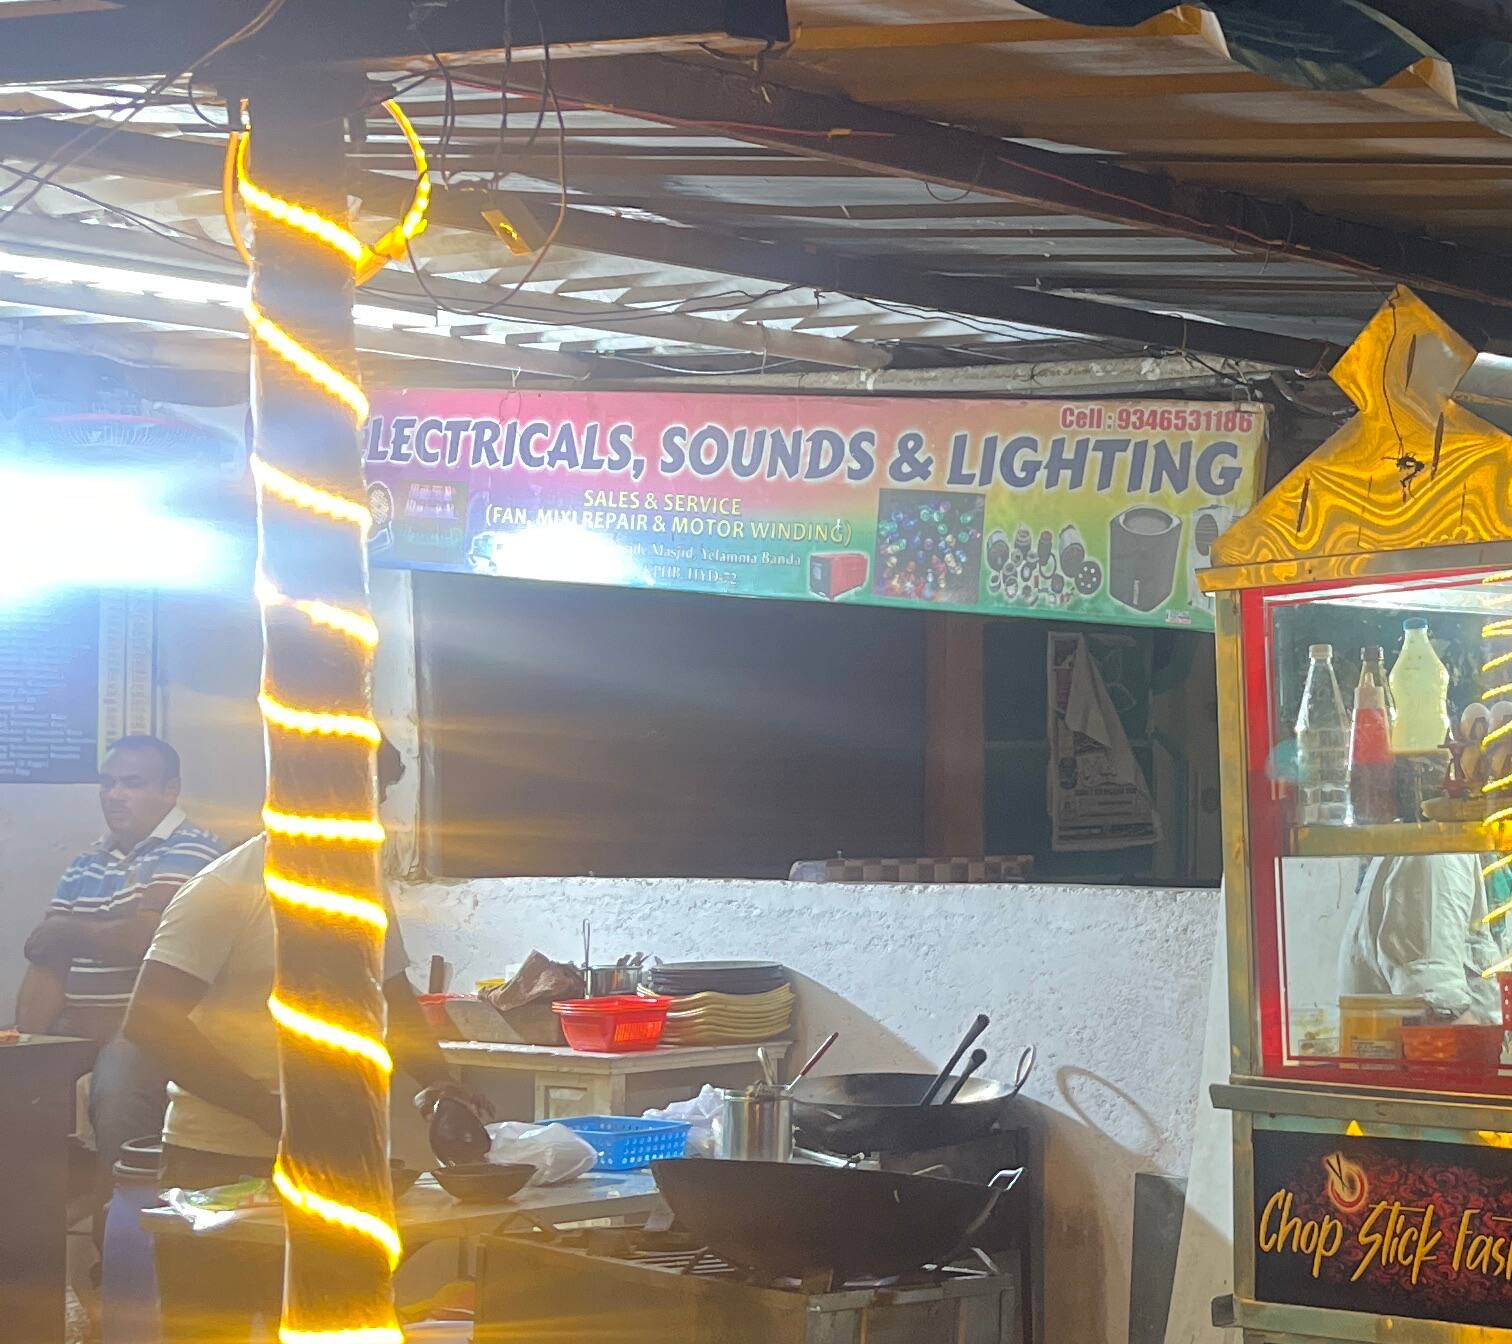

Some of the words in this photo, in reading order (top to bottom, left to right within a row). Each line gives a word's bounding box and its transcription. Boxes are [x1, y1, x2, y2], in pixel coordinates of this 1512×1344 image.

[1116, 408, 1253, 433] 9346531186
[363, 416, 646, 480] LECTRICALS,
[660, 424, 876, 481] SOUNDS
[889, 432, 933, 482] &
[947, 432, 1242, 496] LIGHTING
[584, 489, 639, 509] SALES
[645, 492, 658, 511] &
[664, 494, 742, 516] SERVICE
[653, 515, 666, 533] &
[672, 517, 744, 539] MOTOR
[751, 520, 852, 546] WINDING)
[1259, 1188, 1343, 1280] Chop
[1350, 1202, 1444, 1286] Stick
